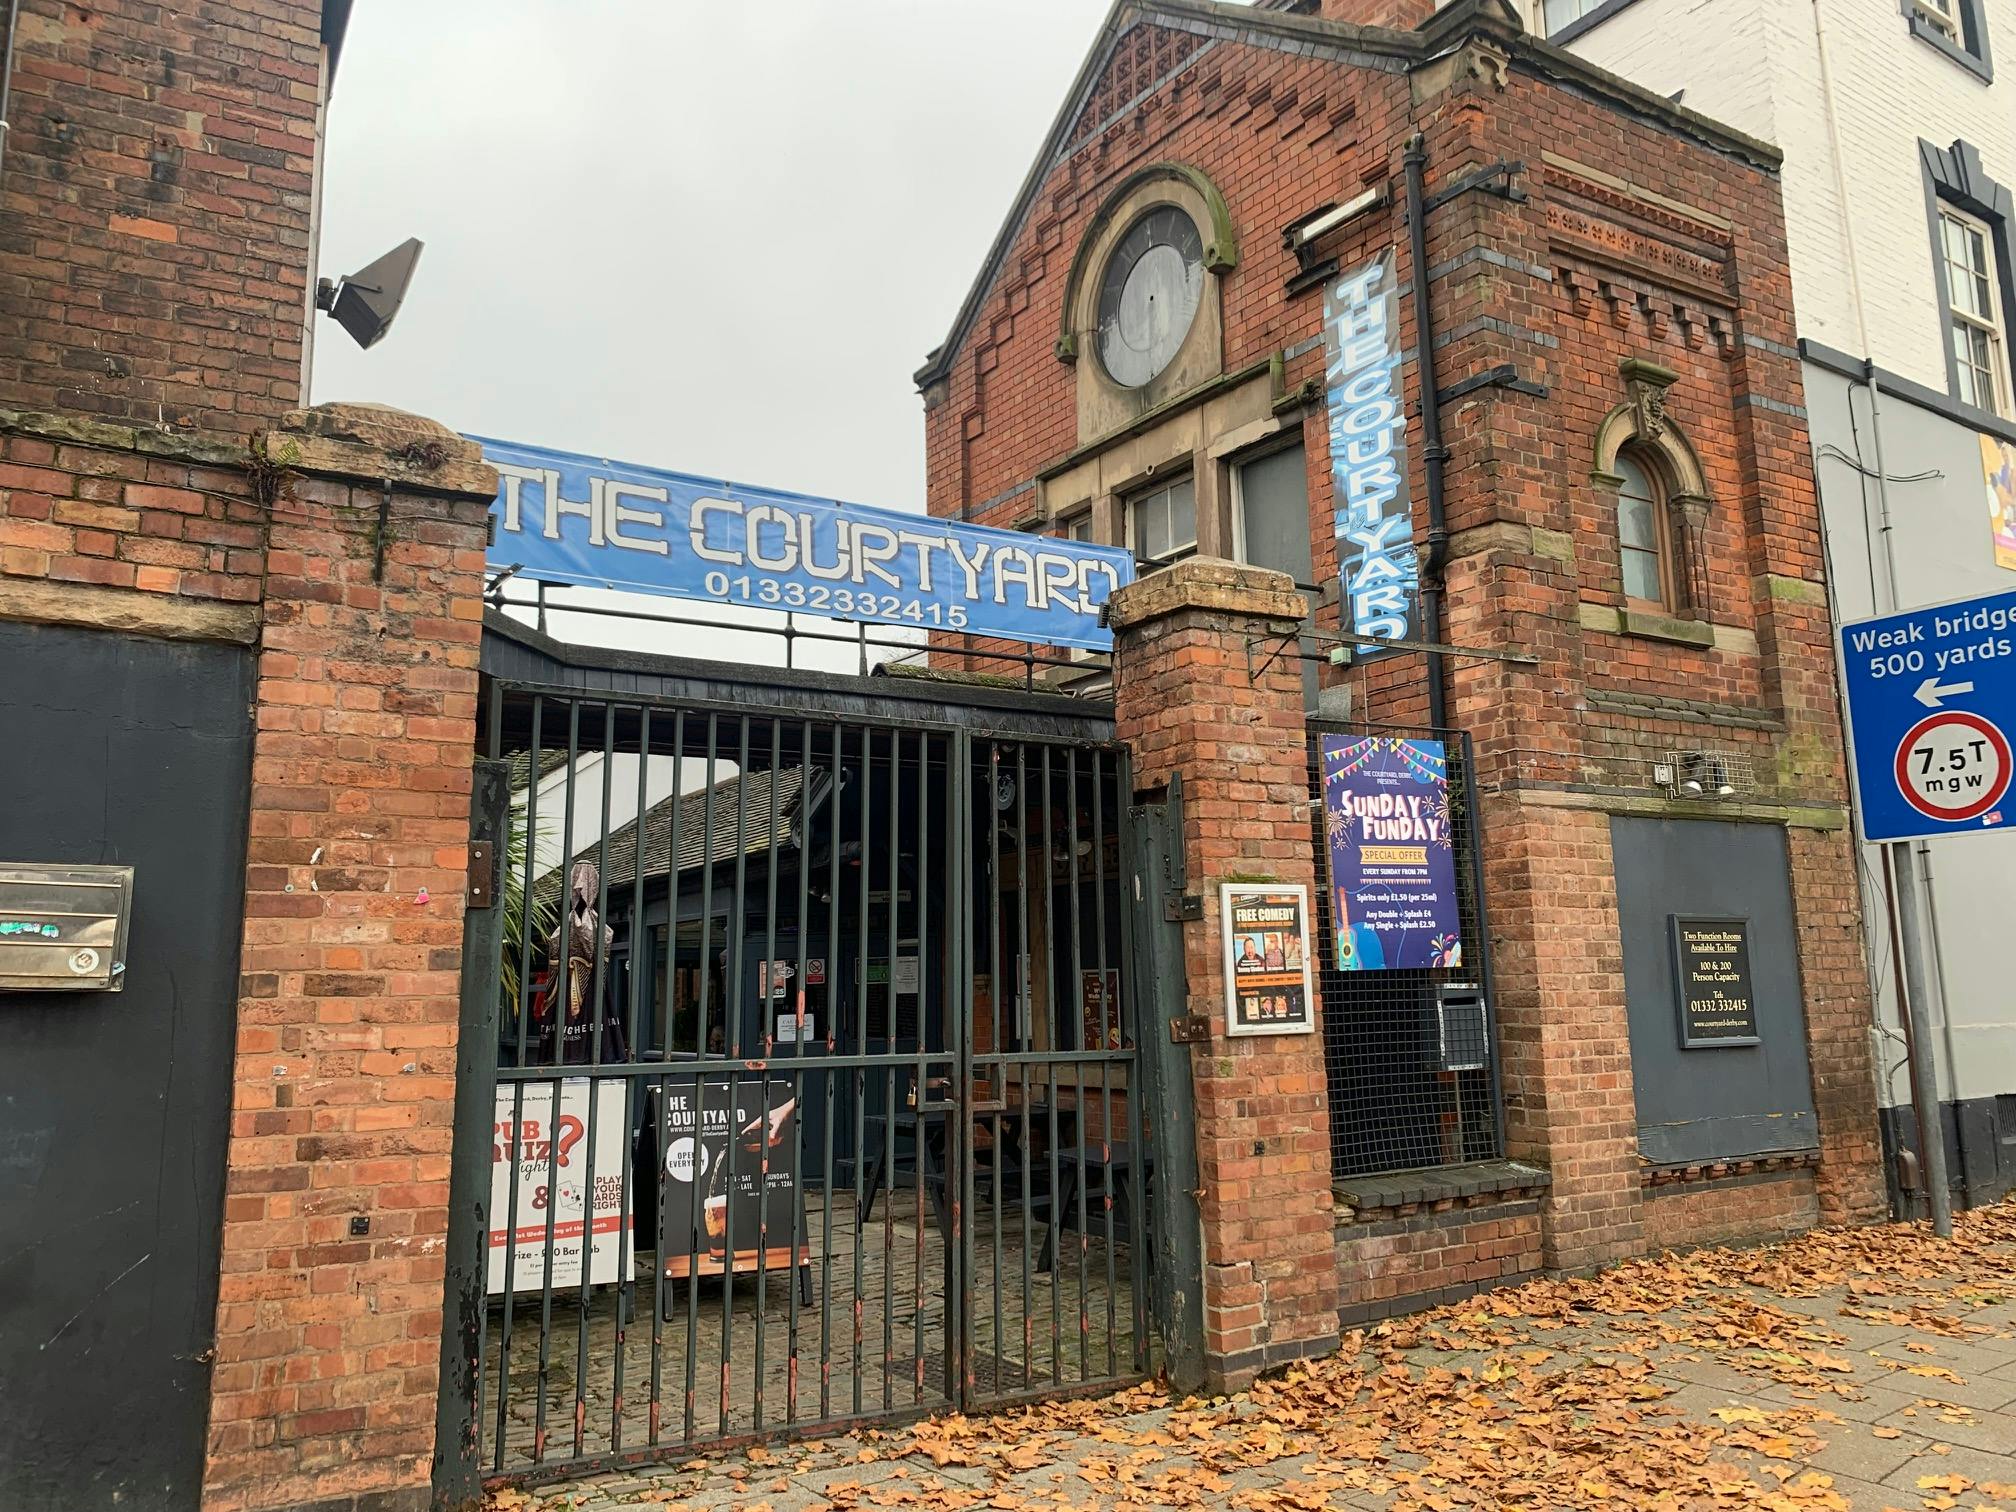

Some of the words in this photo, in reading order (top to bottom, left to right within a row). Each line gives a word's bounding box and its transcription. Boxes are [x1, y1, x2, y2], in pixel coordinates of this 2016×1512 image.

[1336, 264, 1389, 375] THE
[1341, 369, 1408, 655] COURTYARD
[482, 458, 669, 555] THE
[688, 496, 1119, 615] COURTYARD
[704, 571, 969, 628] 01332332415
[1851, 622, 1925, 653] Weak
[1870, 650, 1924, 679] 500
[1935, 637, 2012, 672] yards
[1914, 740, 1987, 775] 7.5T
[1341, 789, 1422, 818] SUNDAY
[1362, 816, 1441, 842] FUNDAY
[1364, 850, 1397, 860] SPECIAL
[1398, 851, 1424, 861] OFFER
[1356, 893, 1377, 903] Spirits
[1377, 893, 1390, 903] only
[1408, 893, 1420, 903] (per
[1420, 893, 1438, 903] 25ml)
[1236, 908, 1258, 922] FREE
[1258, 907, 1295, 922] COMEDY
[1366, 911, 1377, 920] Any
[1378, 910, 1398, 918] Double
[1404, 910, 1423, 919] Splash
[1424, 910, 1432, 918] £4
[1363, 922, 1375, 931] Any
[1375, 921, 1394, 931] Single
[1399, 921, 1419, 930] Splash
[1683, 931, 1697, 940] Two
[1697, 931, 1722, 940] Function
[1722, 931, 1742, 940] Rooms
[1691, 943, 1715, 952] Available
[1715, 943, 1724, 952] To
[1724, 943, 1737, 952] Hire
[1700, 961, 1711, 971] 100
[1711, 961, 1719, 971] &
[1720, 961, 1732, 971] 200
[1692, 972, 1714, 981] Person
[1714, 971, 1740, 982] Capacity
[1691, 1000, 1717, 1012] 01332
[1717, 999, 1747, 1011] 332415
[669, 1096, 688, 1111] HE
[667, 1108, 747, 1126] OUTYAD
[669, 1159, 705, 1168] EVERYY
[519, 1159, 550, 1182] ight
[596, 1175, 622, 1185] PLAY
[741, 1174, 751, 1182] SAT
[594, 1184, 622, 1193] YOUR
[740, 1182, 753, 1190] LATE
[594, 1192, 622, 1202] ARDS
[513, 1249, 532, 1260] rize
[562, 1246, 581, 1257] Bar
